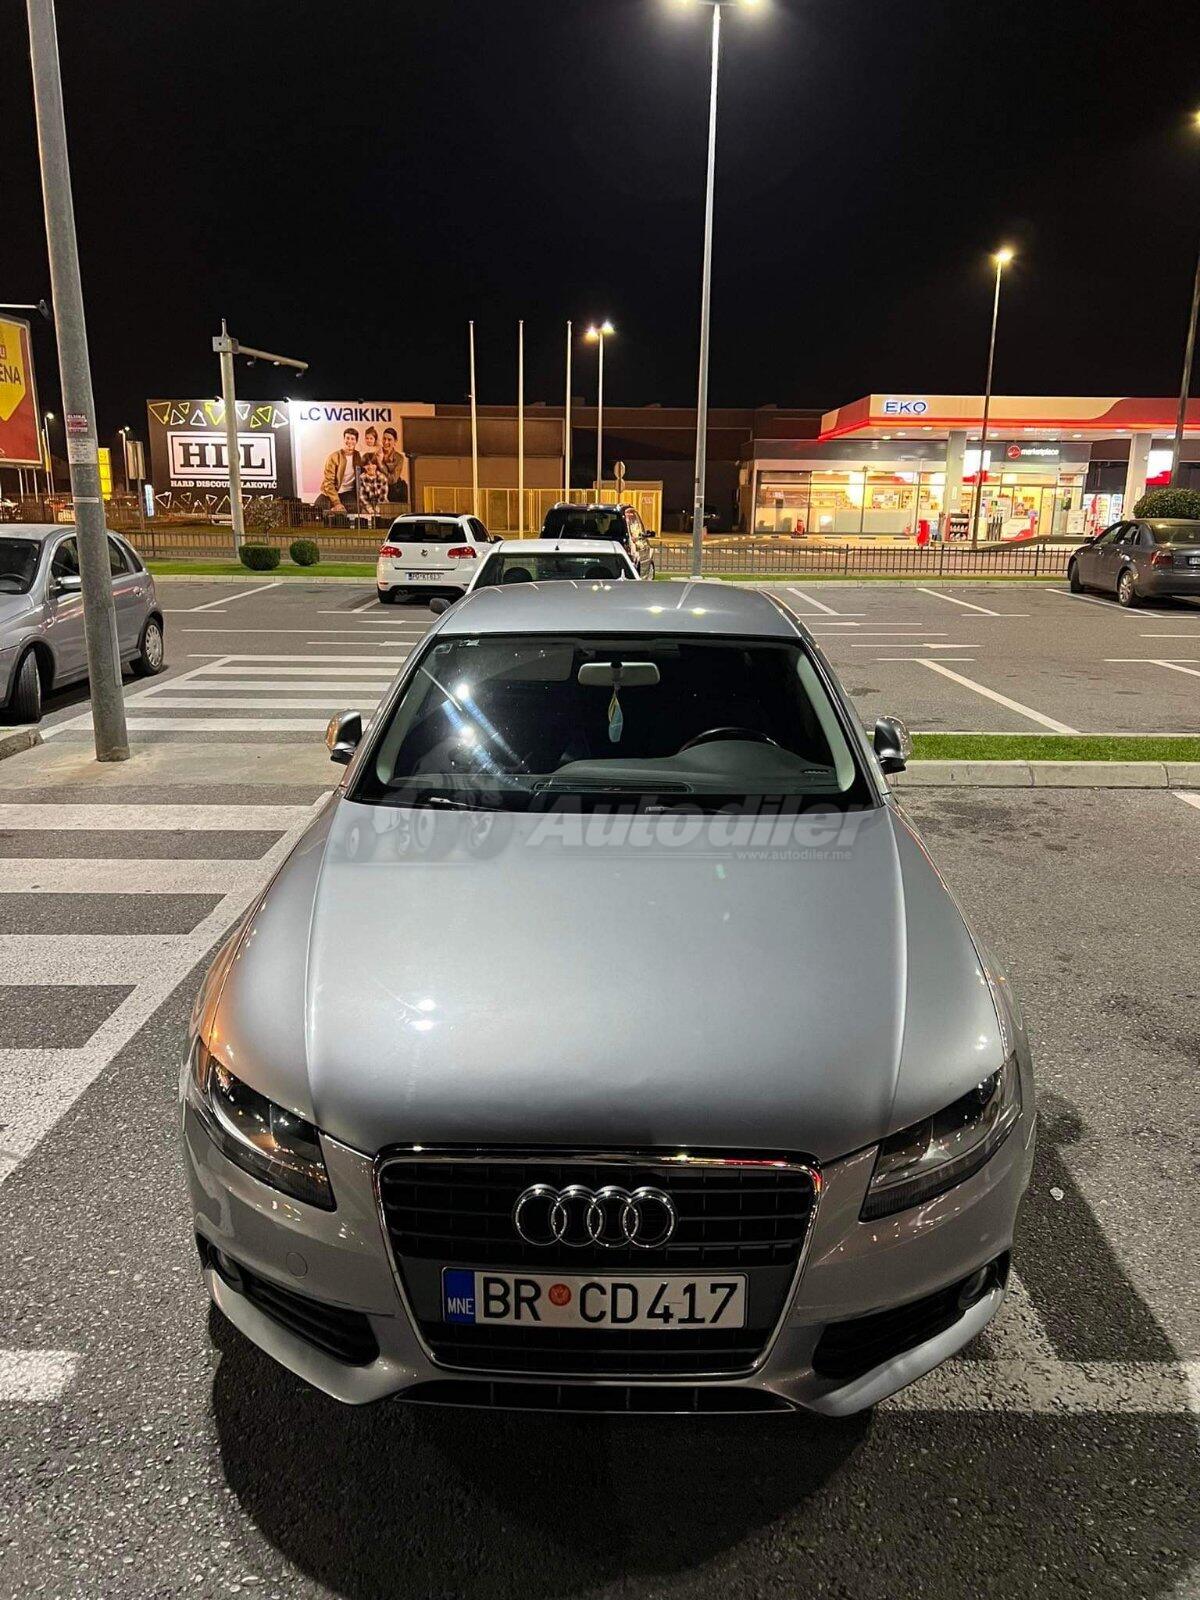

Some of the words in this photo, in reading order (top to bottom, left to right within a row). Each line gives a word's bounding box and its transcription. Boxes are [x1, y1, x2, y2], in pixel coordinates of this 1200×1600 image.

[886, 401, 927, 413] EKO
[300, 407, 321, 421] LC
[170, 480, 195, 488] HARD
[448, 1297, 475, 1316] MNE
[483, 1276, 542, 1322] BR
